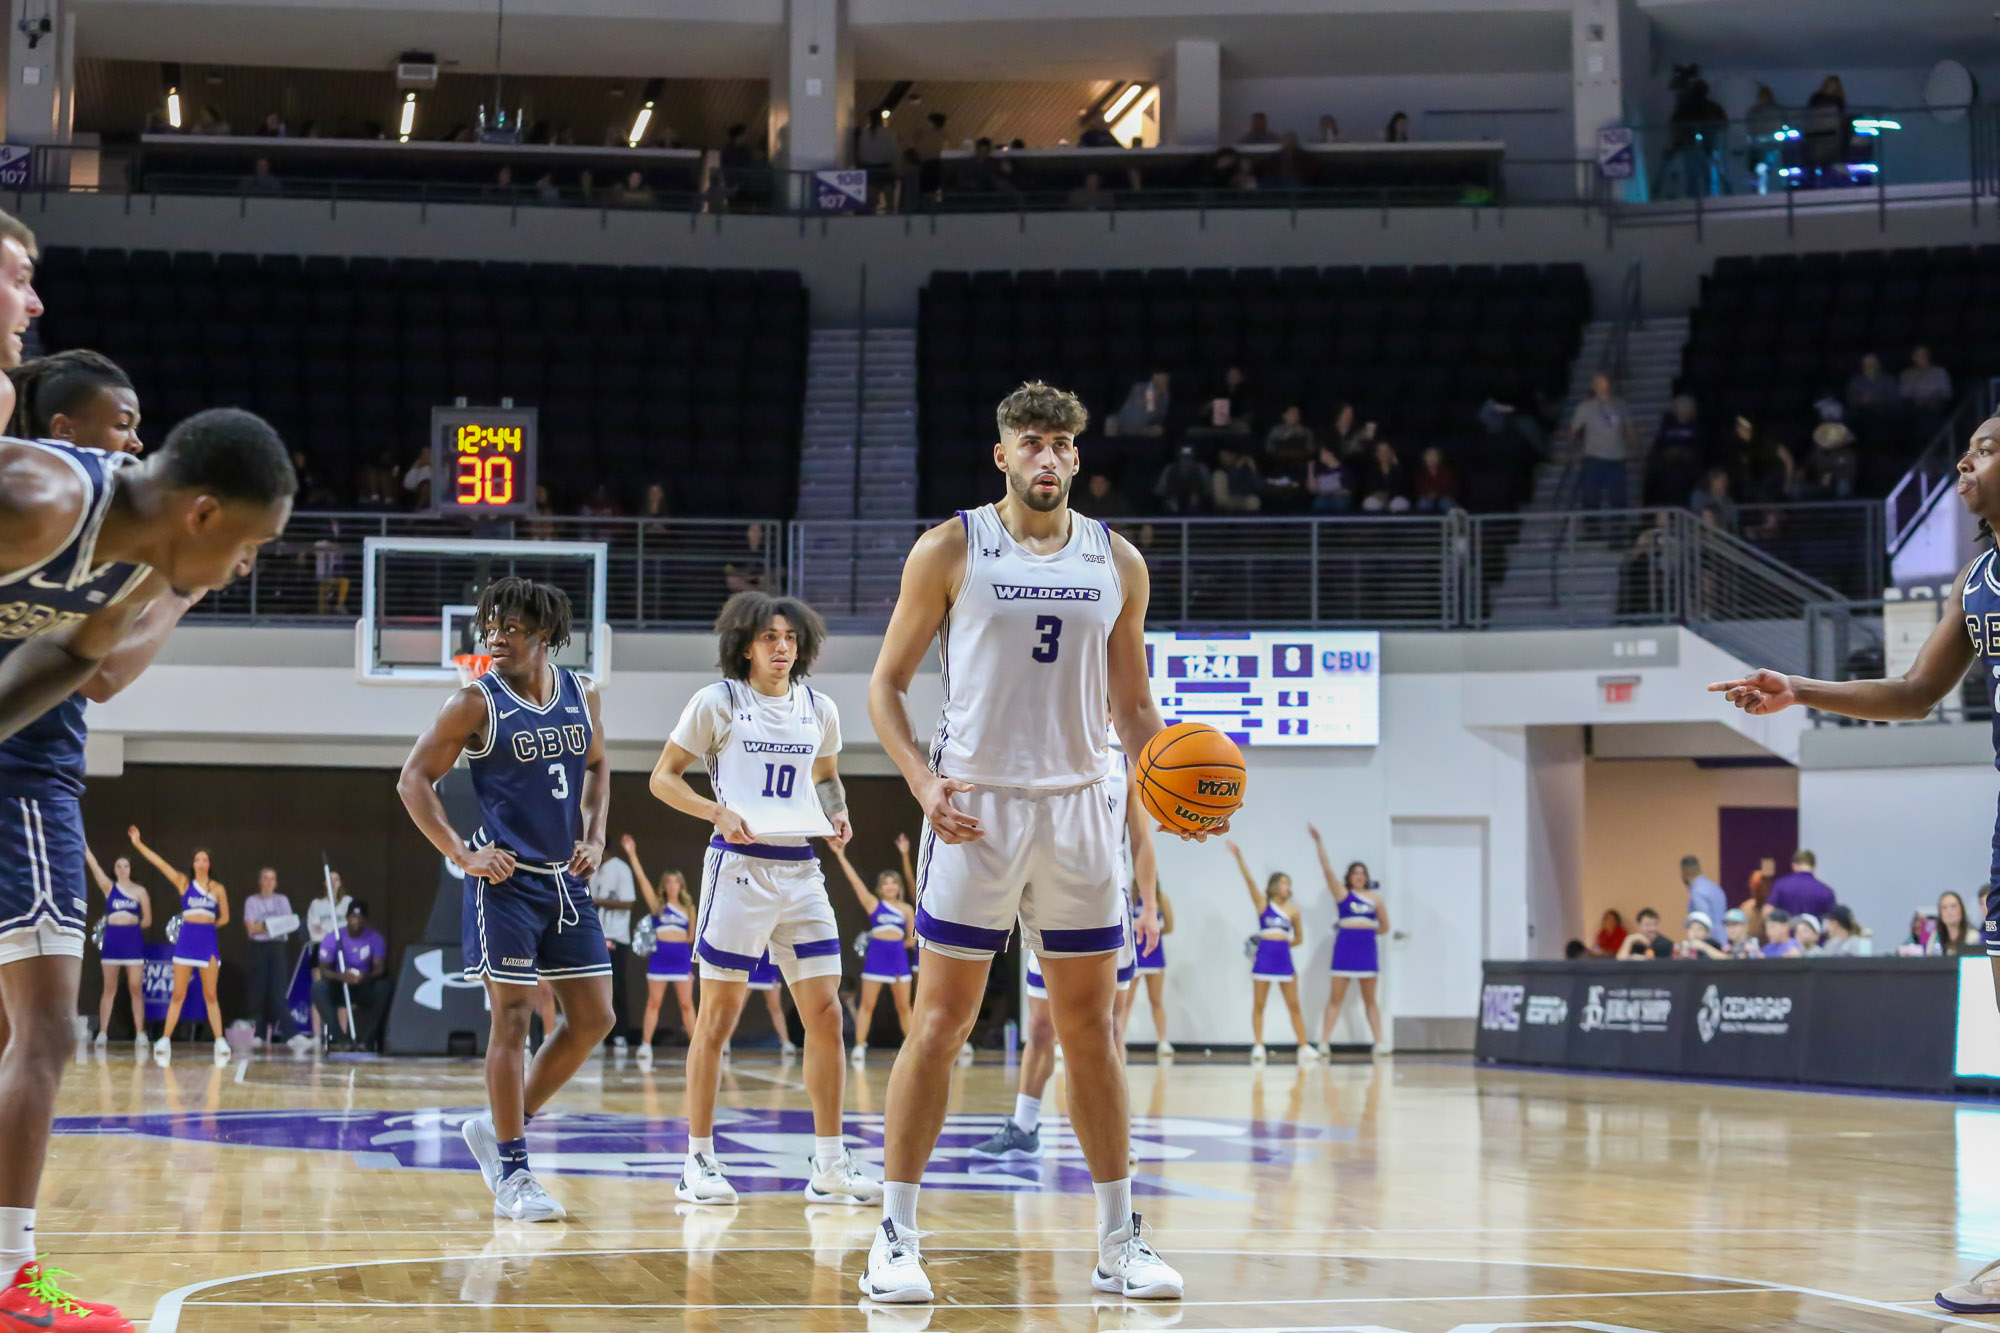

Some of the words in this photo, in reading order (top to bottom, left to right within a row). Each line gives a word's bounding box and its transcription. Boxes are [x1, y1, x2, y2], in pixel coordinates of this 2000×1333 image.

[0, 169, 27, 184] 107
[819, 194, 847, 208] 107
[457, 424, 522, 454] 12:44
[457, 455, 513, 505] 30
[1082, 552, 1105, 564] WAC
[992, 584, 1101, 602] WILDCATS
[1032, 614, 1063, 663] 3
[1321, 651, 1371, 671] CBU
[512, 723, 587, 763] CBU
[743, 740, 814, 755] WILDCATS
[548, 763, 569, 800] 3
[762, 763, 796, 799] 10
[1197, 780, 1241, 796] NCAA
